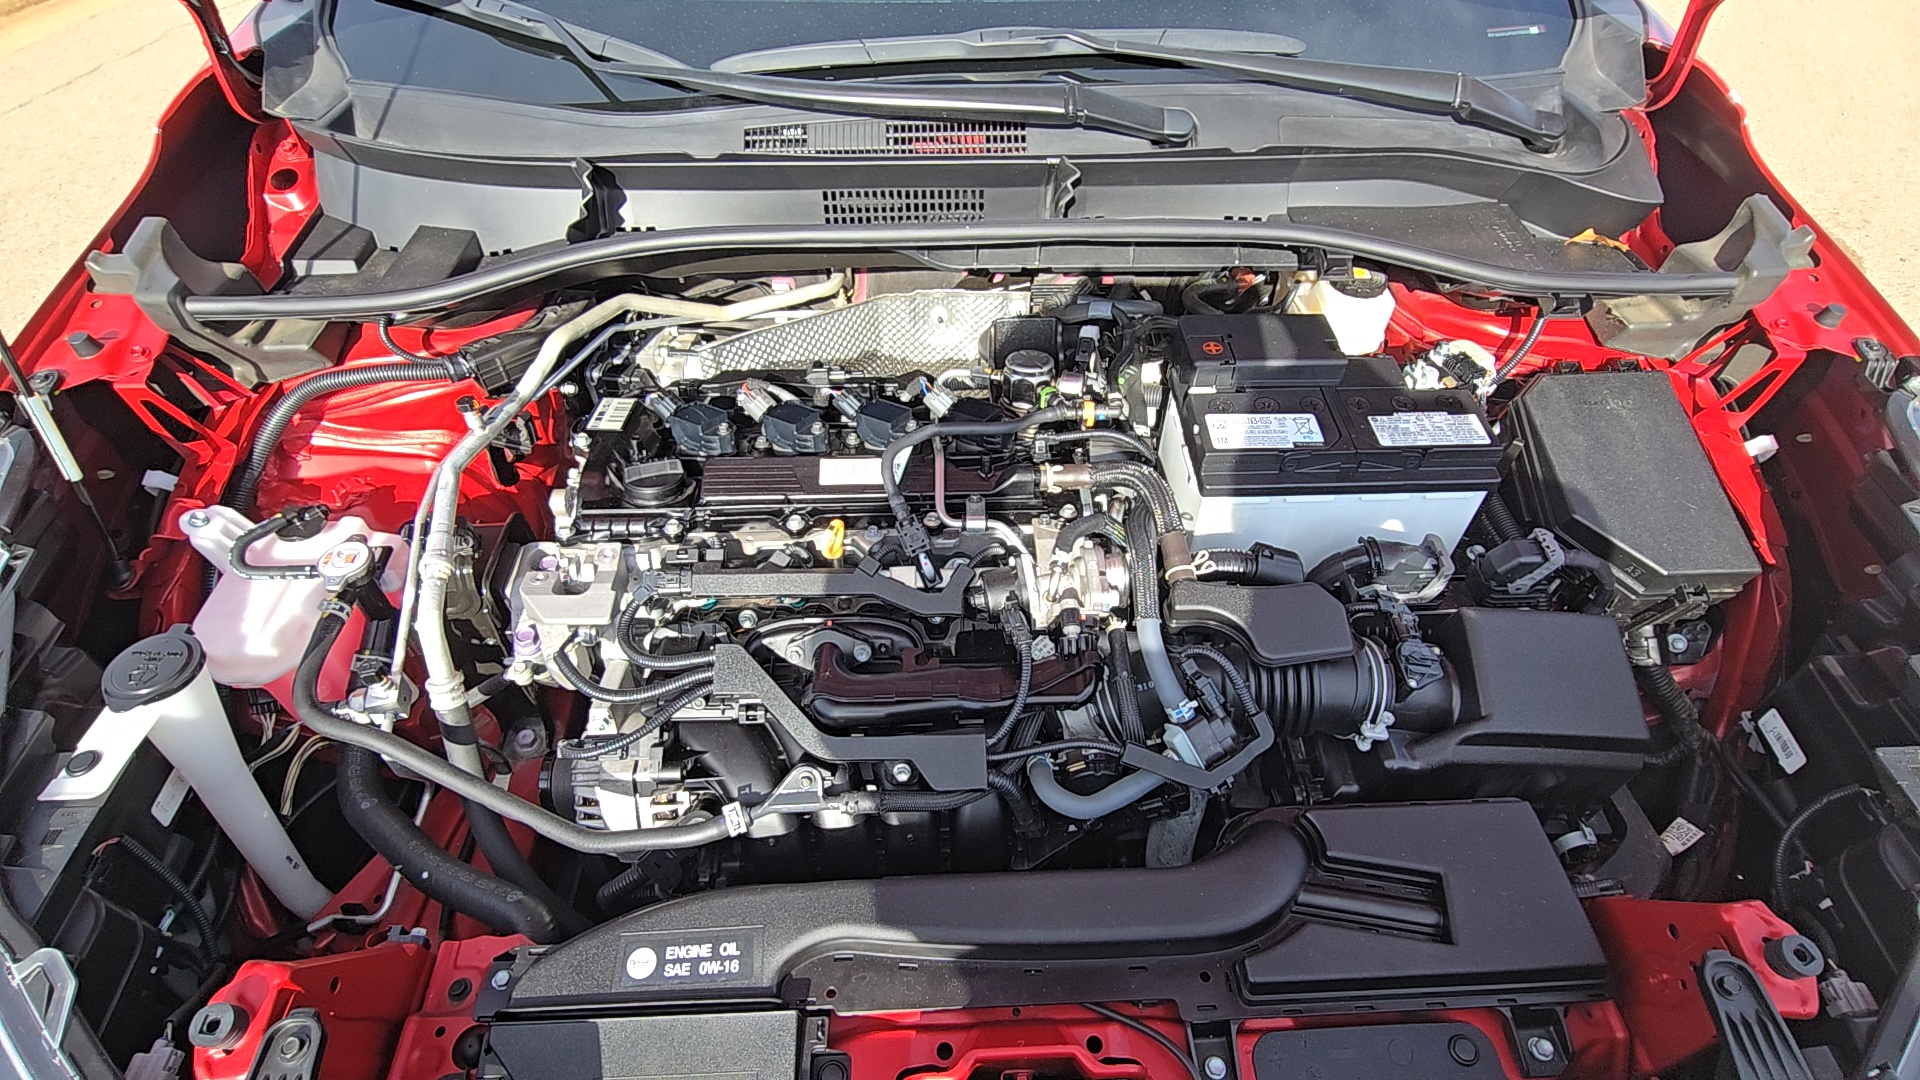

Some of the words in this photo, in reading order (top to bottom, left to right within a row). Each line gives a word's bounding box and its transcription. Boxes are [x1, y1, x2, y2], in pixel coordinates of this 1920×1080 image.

[1624, 565, 1642, 577] A3
[665, 943, 713, 959] ENGINE
[719, 942, 741, 956] OIL
[663, 962, 692, 977] SAE
[698, 959, 740, 975] 0W-16
